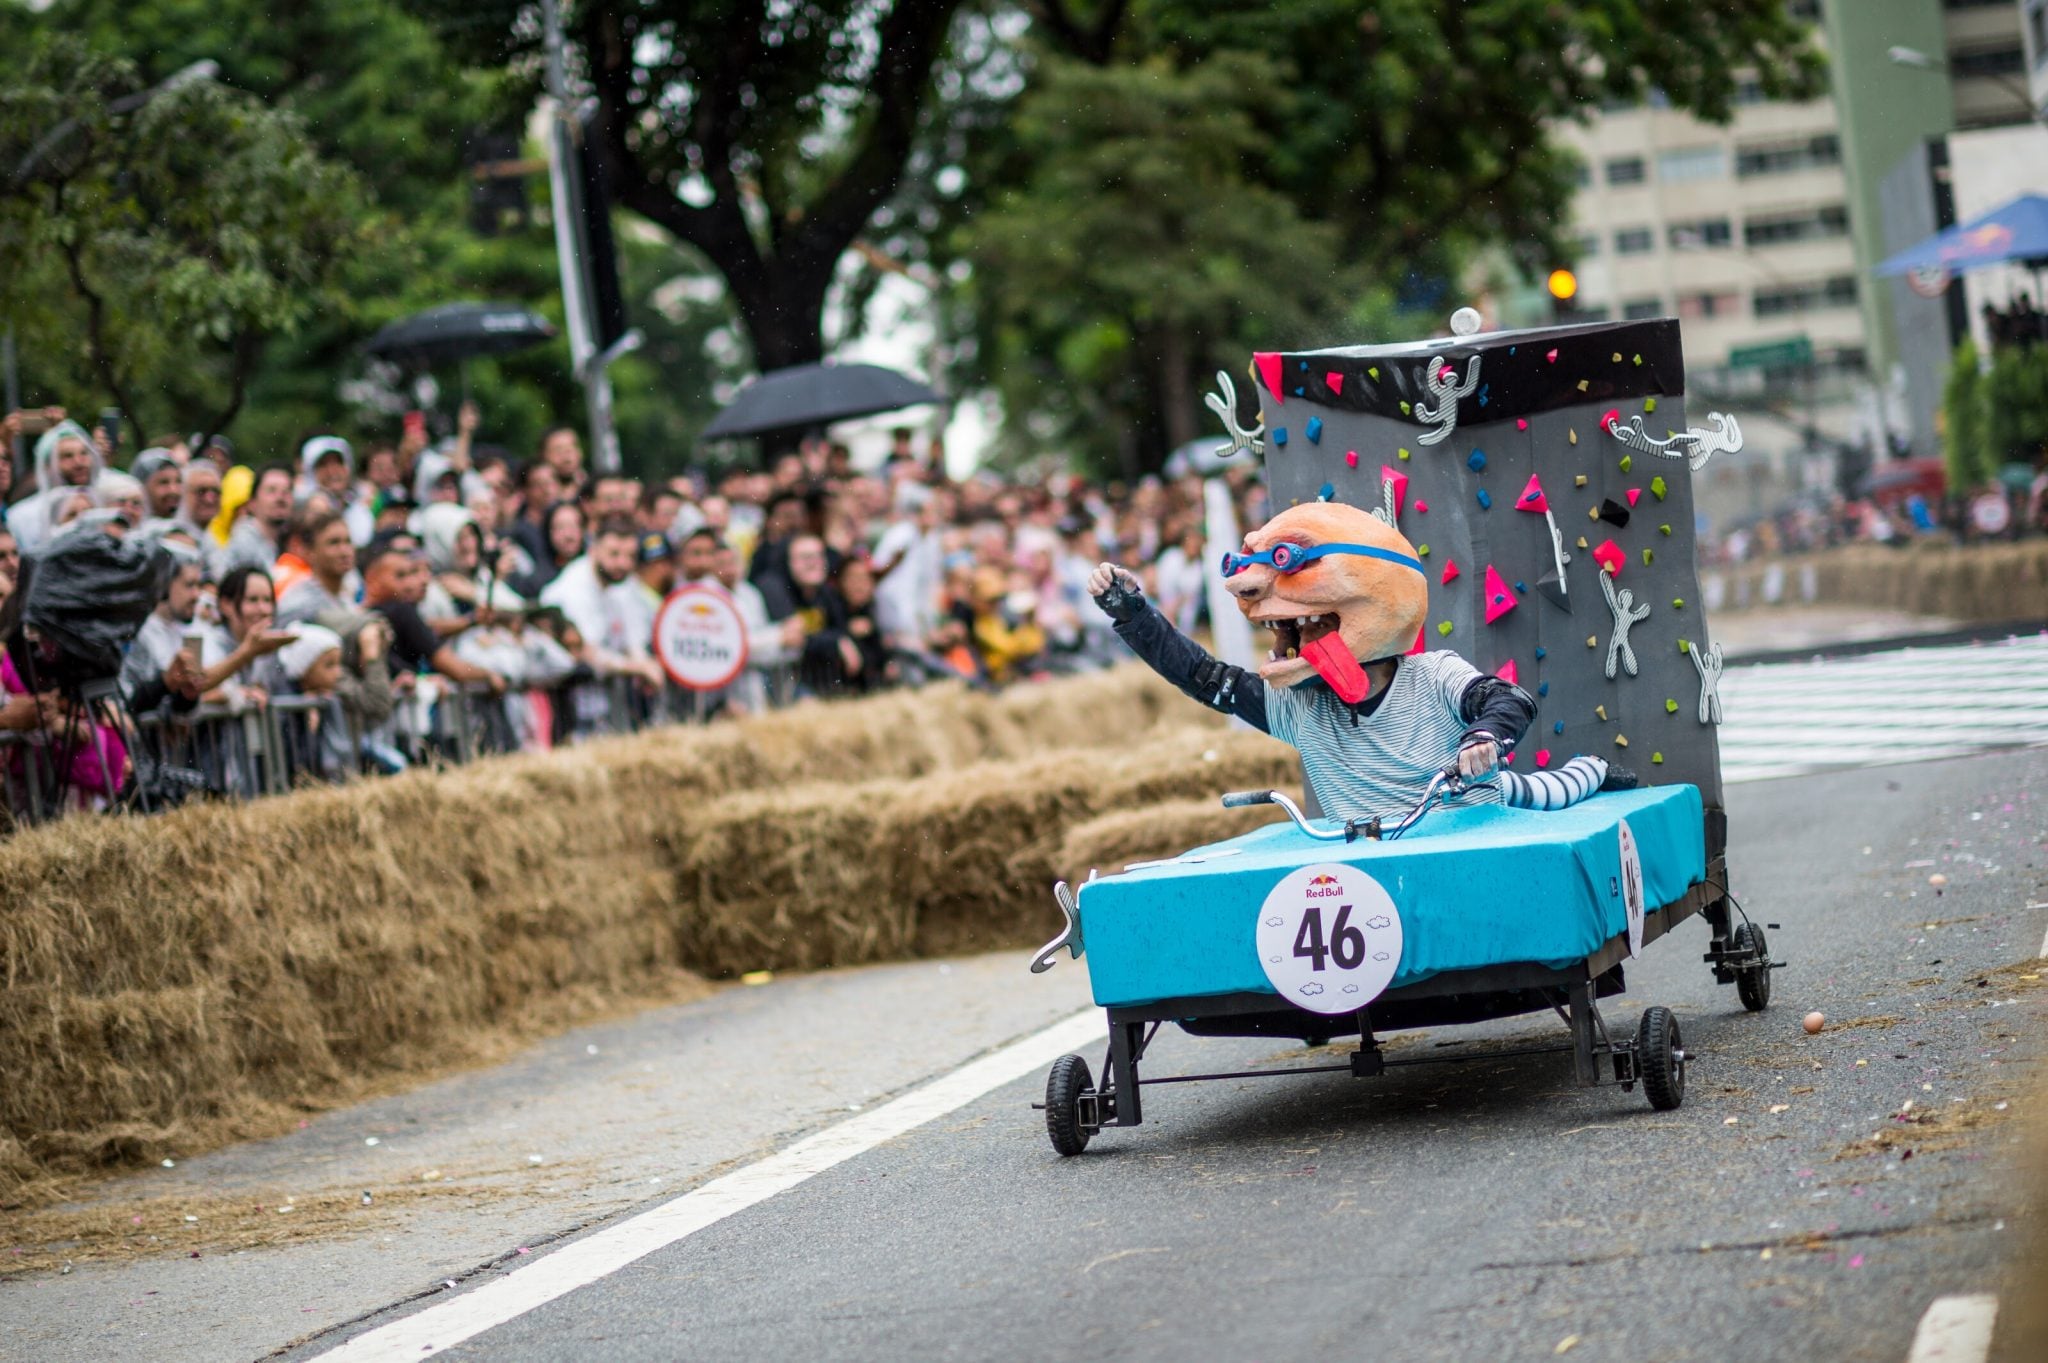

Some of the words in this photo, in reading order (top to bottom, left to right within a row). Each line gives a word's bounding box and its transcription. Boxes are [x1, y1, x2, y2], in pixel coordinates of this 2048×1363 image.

[1306, 888, 1324, 898] Red
[1325, 886, 1343, 897] Bull
[1293, 905, 1366, 971] 46
